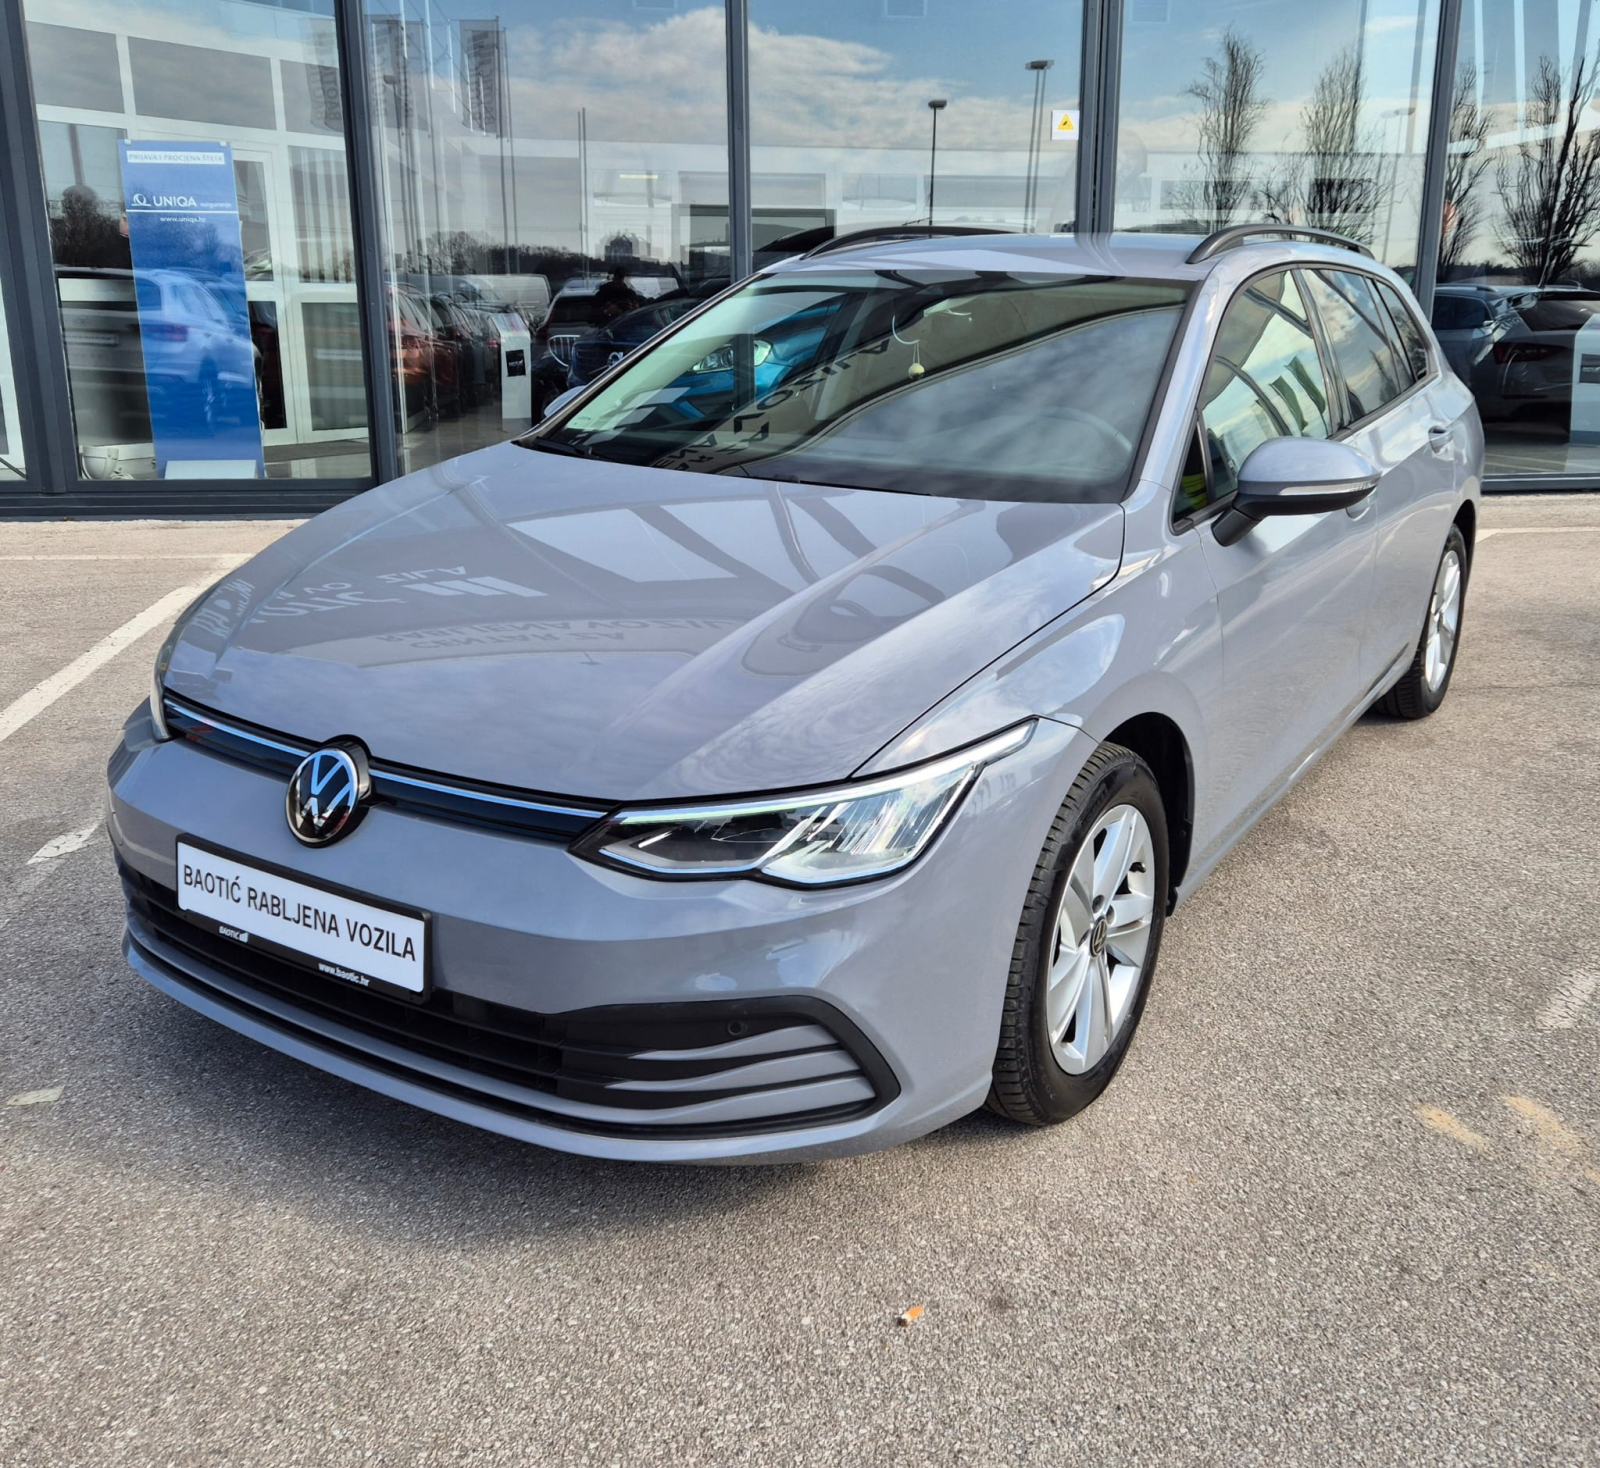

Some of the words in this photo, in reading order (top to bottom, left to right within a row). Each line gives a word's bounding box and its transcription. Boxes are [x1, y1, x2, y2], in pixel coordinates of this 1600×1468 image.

[153, 196, 198, 207] UNIQA
[183, 864, 241, 903] BAOTIĆ
[247, 886, 340, 938] RABLJENA
[345, 918, 416, 962] VOZILA
[318, 962, 370, 987] www.baotic.hr
